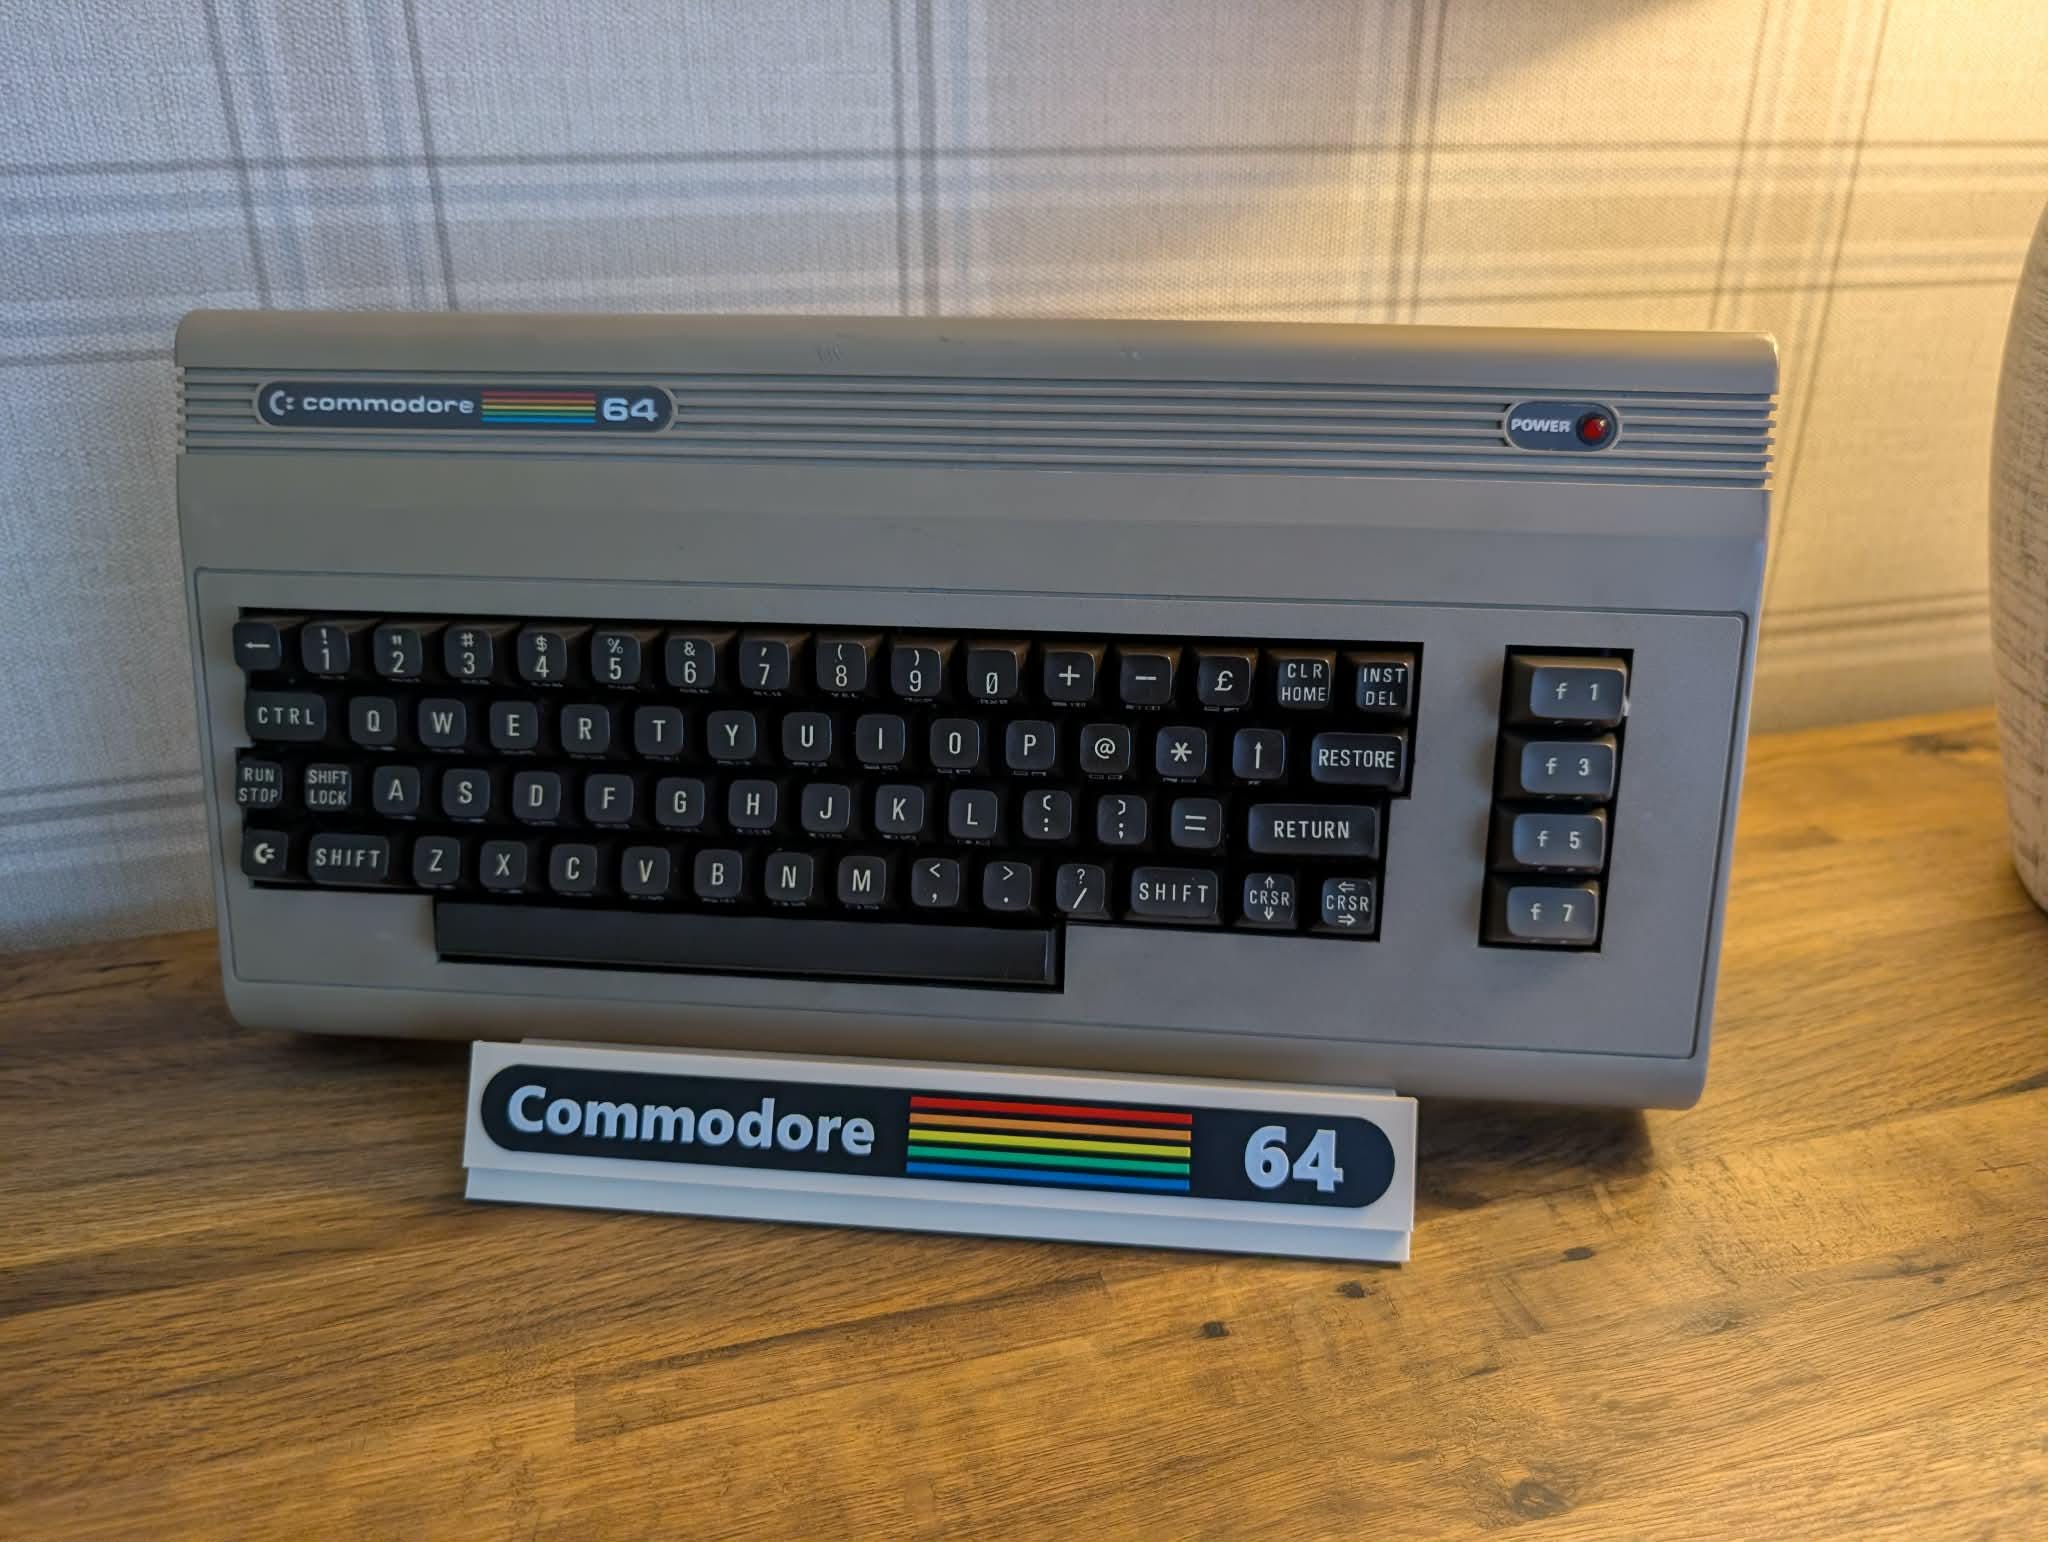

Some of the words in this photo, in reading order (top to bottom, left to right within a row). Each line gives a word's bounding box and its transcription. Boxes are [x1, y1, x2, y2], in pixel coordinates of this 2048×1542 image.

[303, 395, 474, 414] commodore
[602, 397, 658, 422] 64
[1511, 418, 1571, 433] POWER
[460, 632, 474, 648] #
[535, 635, 548, 652] $
[607, 637, 624, 654] %
[683, 641, 696, 657] &
[321, 650, 330, 670] 1
[392, 651, 405, 673] 2
[463, 651, 476, 675] 3
[535, 655, 550, 678] 4
[609, 657, 622, 680] 5
[1287, 663, 1323, 679] CLR
[684, 660, 697, 684] 6
[759, 663, 770, 686] 7
[835, 664, 848, 687] 8
[909, 670, 922, 693] 9
[1058, 665, 1081, 686] +
[1214, 670, 1233, 692] £
[1363, 664, 1407, 683] INST
[1281, 686, 1326, 702] HOME
[1365, 690, 1397, 706] DEL
[257, 706, 314, 726] CTRL
[367, 709, 381, 732] Q
[432, 711, 454, 734] W
[507, 714, 520, 737] E
[578, 717, 592, 740] R
[652, 719, 666, 742] T
[725, 724, 739, 747] Y
[801, 725, 814, 748] U
[878, 727, 883, 750] I
[948, 731, 962, 755] O
[1023, 734, 1037, 756] P
[1094, 737, 1116, 759] @
[1318, 748, 1395, 769] RESTORE
[243, 767, 274, 783] RUN
[307, 769, 348, 785] SHIFT
[238, 787, 279, 803] STOP
[309, 789, 347, 806] LOCK
[388, 778, 404, 801] A
[459, 781, 473, 804] S
[530, 784, 544, 807] D
[603, 787, 616, 809] F
[674, 790, 687, 814] G
[746, 792, 760, 816] H
[819, 796, 833, 819] J
[892, 797, 907, 821] K
[966, 802, 979, 825] L
[1184, 814, 1207, 832] =
[1274, 820, 1350, 839] RETURN
[315, 847, 381, 868] SHIFT
[429, 849, 443, 872] Z
[496, 853, 511, 876] X
[567, 856, 580, 880] C
[639, 859, 653, 883] V
[711, 862, 724, 886] B
[781, 865, 797, 889] N
[852, 869, 871, 892] M
[929, 863, 941, 878] <
[1002, 865, 1014, 881] >
[1076, 868, 1086, 885] ?
[1072, 887, 1088, 909] /
[1138, 882, 1209, 903] SHIFT
[1249, 889, 1290, 906] CRSR
[1326, 894, 1369, 912] CRSR
[506, 1085, 877, 1158] Commodore
[1244, 1125, 1344, 1193] 64
